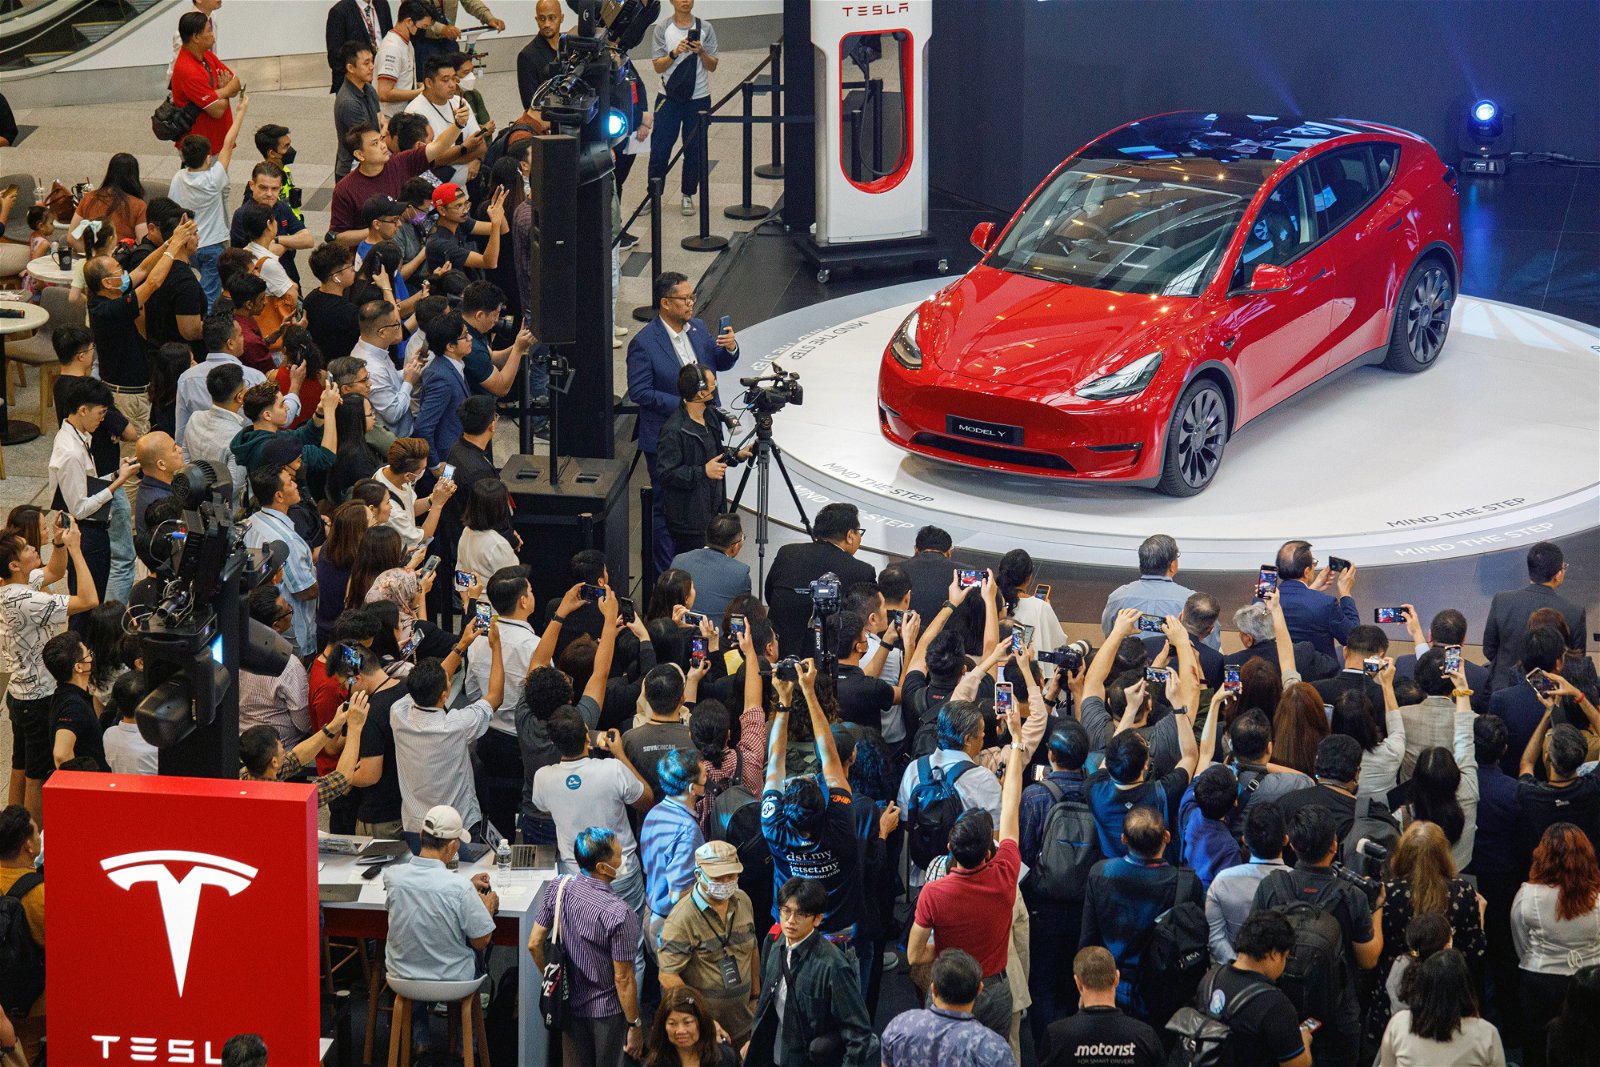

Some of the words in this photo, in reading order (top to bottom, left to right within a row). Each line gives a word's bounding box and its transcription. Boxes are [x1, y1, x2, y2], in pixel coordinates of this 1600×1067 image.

[842, 2, 909, 17] TESLA
[833, 320, 869, 335] MIND
[807, 333, 838, 346] THE
[789, 344, 817, 360] STEP
[958, 424, 997, 436] MODEL
[822, 462, 861, 480] MIND
[859, 476, 893, 491] THE
[889, 487, 935, 503] STEP
[1386, 515, 1440, 528] MIND
[1440, 507, 1483, 519] THE
[1482, 496, 1526, 511] STEP
[862, 512, 916, 529] STEP
[1394, 543, 1456, 557] MIND
[1456, 534, 1506, 548] THE
[1504, 522, 1555, 538] STEP
[786, 850, 832, 861] dsf.my
[543, 962, 560, 978] 17
[91, 1035, 223, 1065] TESL
[1074, 1042, 1136, 1057] motorist
